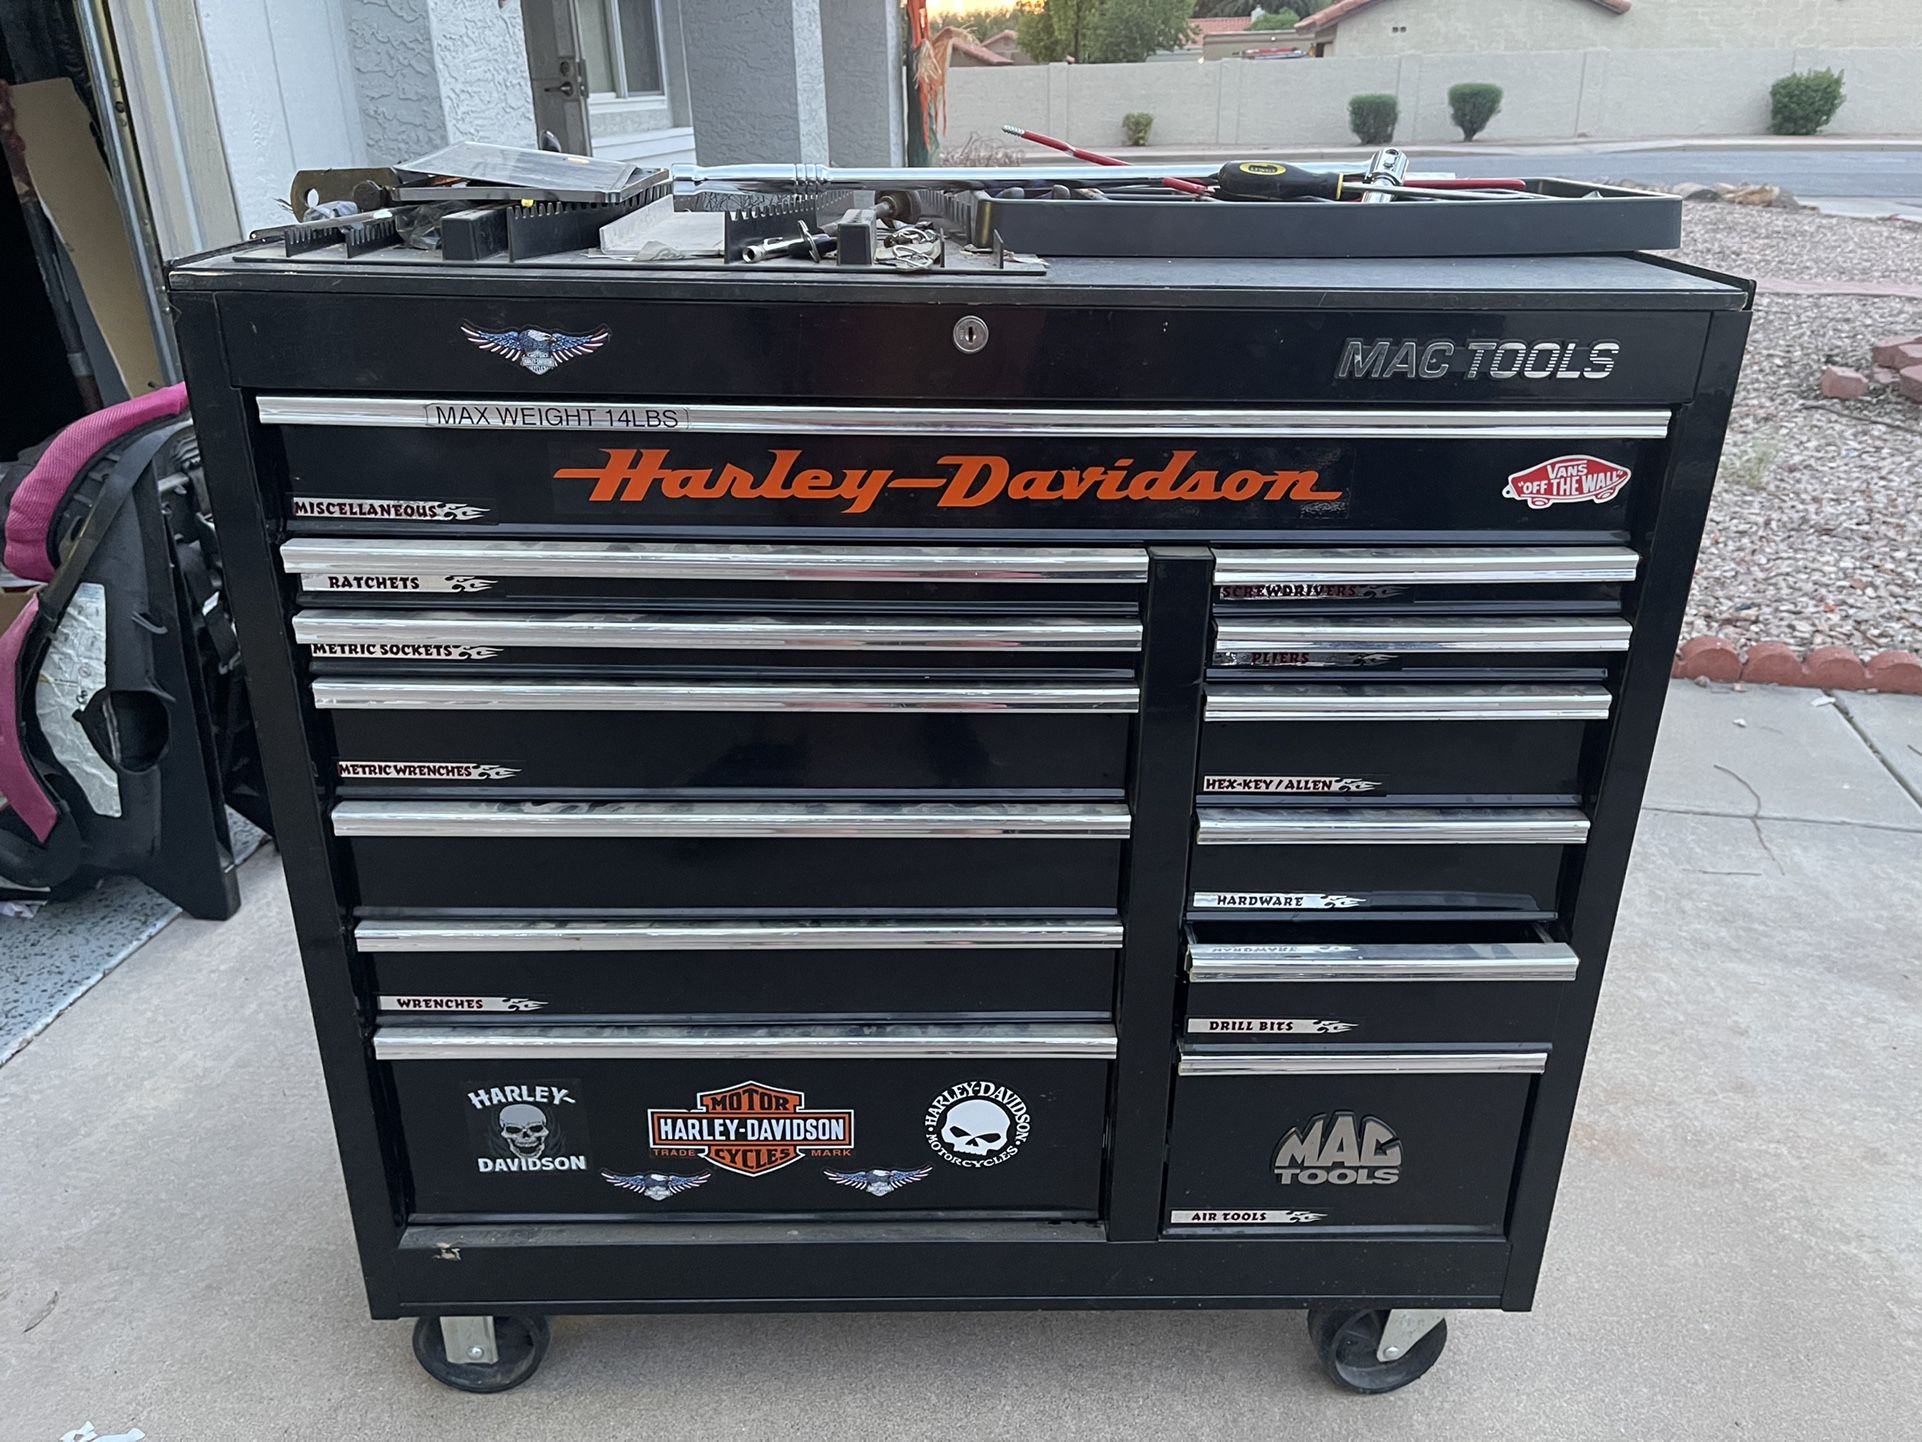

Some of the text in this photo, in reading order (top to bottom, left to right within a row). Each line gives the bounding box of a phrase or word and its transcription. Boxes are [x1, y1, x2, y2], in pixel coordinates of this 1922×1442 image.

[1338, 340, 1620, 379] MAC TOOLS
[436, 406, 678, 428] MAX WEIGHT 14LBS
[1546, 460, 1587, 479] VANS
[553, 448, 1342, 514] Harley-Davidson
[1551, 476, 1579, 495] THE
[295, 502, 438, 518] MISCELLANEOUS
[328, 576, 420, 589] RATCHETS
[1222, 584, 1357, 597] SCREWDRIVERS
[313, 643, 453, 657] METRIC SOCKETS
[1251, 652, 1310, 664] PLIERS
[339, 763, 472, 777] METRIC WRENCHES
[1217, 895, 1304, 907] HARDWARE
[397, 998, 484, 1009] WRENCHES
[1209, 1020, 1294, 1031] DRILL BITS
[710, 1088, 790, 1111] MOTOR
[925, 1081, 1031, 1142] HARLEY-DAVIDSON
[660, 1118, 844, 1141] HARLEY-DAVIDSON
[1273, 1113, 1402, 1167] MAC
[654, 1149, 696, 1157] TRADE
[714, 1146, 791, 1169] CYCLES
[811, 1149, 851, 1157] MARK
[926, 1133, 1019, 1167] MOTORCYCLES
[477, 1155, 587, 1172] DAVIDSON
[1274, 1168, 1400, 1185] TOOLS
[1191, 1212, 1267, 1221] AIR TOOLS
